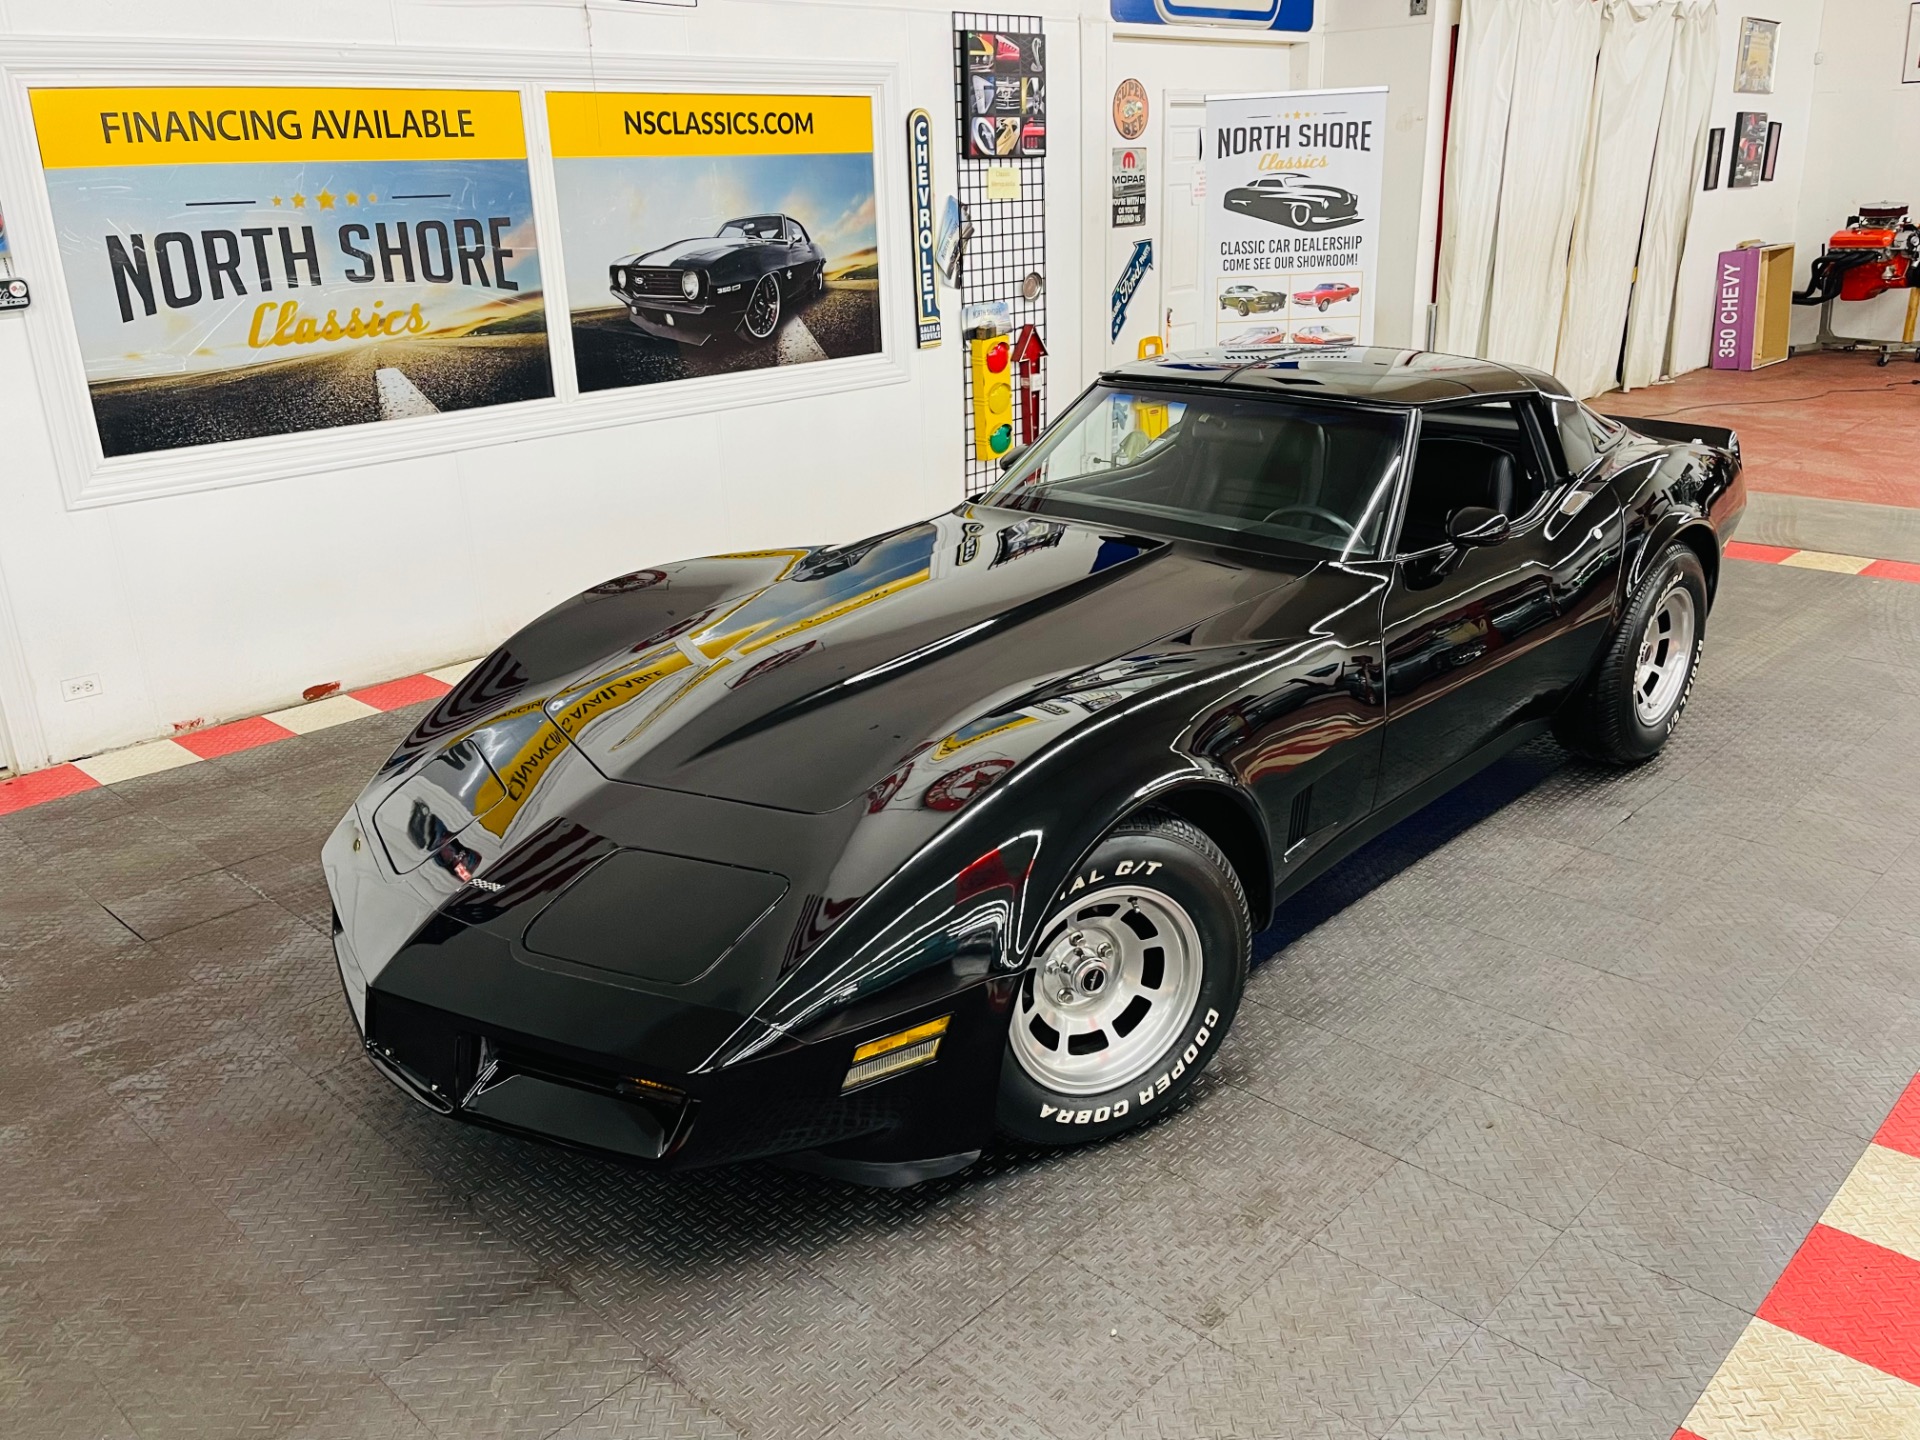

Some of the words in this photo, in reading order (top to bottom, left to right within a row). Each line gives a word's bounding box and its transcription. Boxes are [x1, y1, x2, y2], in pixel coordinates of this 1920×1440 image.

[1116, 82, 1146, 112] SUPER
[100, 110, 302, 144] FINANCING
[311, 108, 475, 139] AVAILABLE
[624, 111, 814, 135] NSCLASSICS.COM
[1121, 114, 1144, 137] BEE
[1217, 125, 1290, 159] NORTH
[1299, 121, 1372, 152] SHORE
[1258, 153, 1329, 171] Classics
[1112, 175, 1145, 184] MOPAR
[1127, 196, 1139, 205] WITH
[915, 121, 933, 313] CHEVROLET
[1116, 214, 1134, 224] BEHIND
[1220, 240, 1265, 255] CLASSIC
[1268, 239, 1290, 253] CAR
[1294, 235, 1363, 252] DEALERSHIP
[105, 224, 322, 324] NORTH
[338, 217, 519, 291] SHORE
[1222, 258, 1250, 271] COME
[1253, 257, 1271, 270] SEE
[1274, 256, 1294, 269] OUR
[1296, 254, 1358, 268] SHOWROOM!
[1120, 260, 1142, 303] Ford
[1720, 264, 1740, 324] CHEVY
[247, 300, 430, 349] Classics
[1718, 328, 1737, 358] 350
[1115, 860, 1163, 876] G/T
[1138, 1008, 1220, 1106] COOPER
[1040, 1099, 1129, 1124] COBRA
